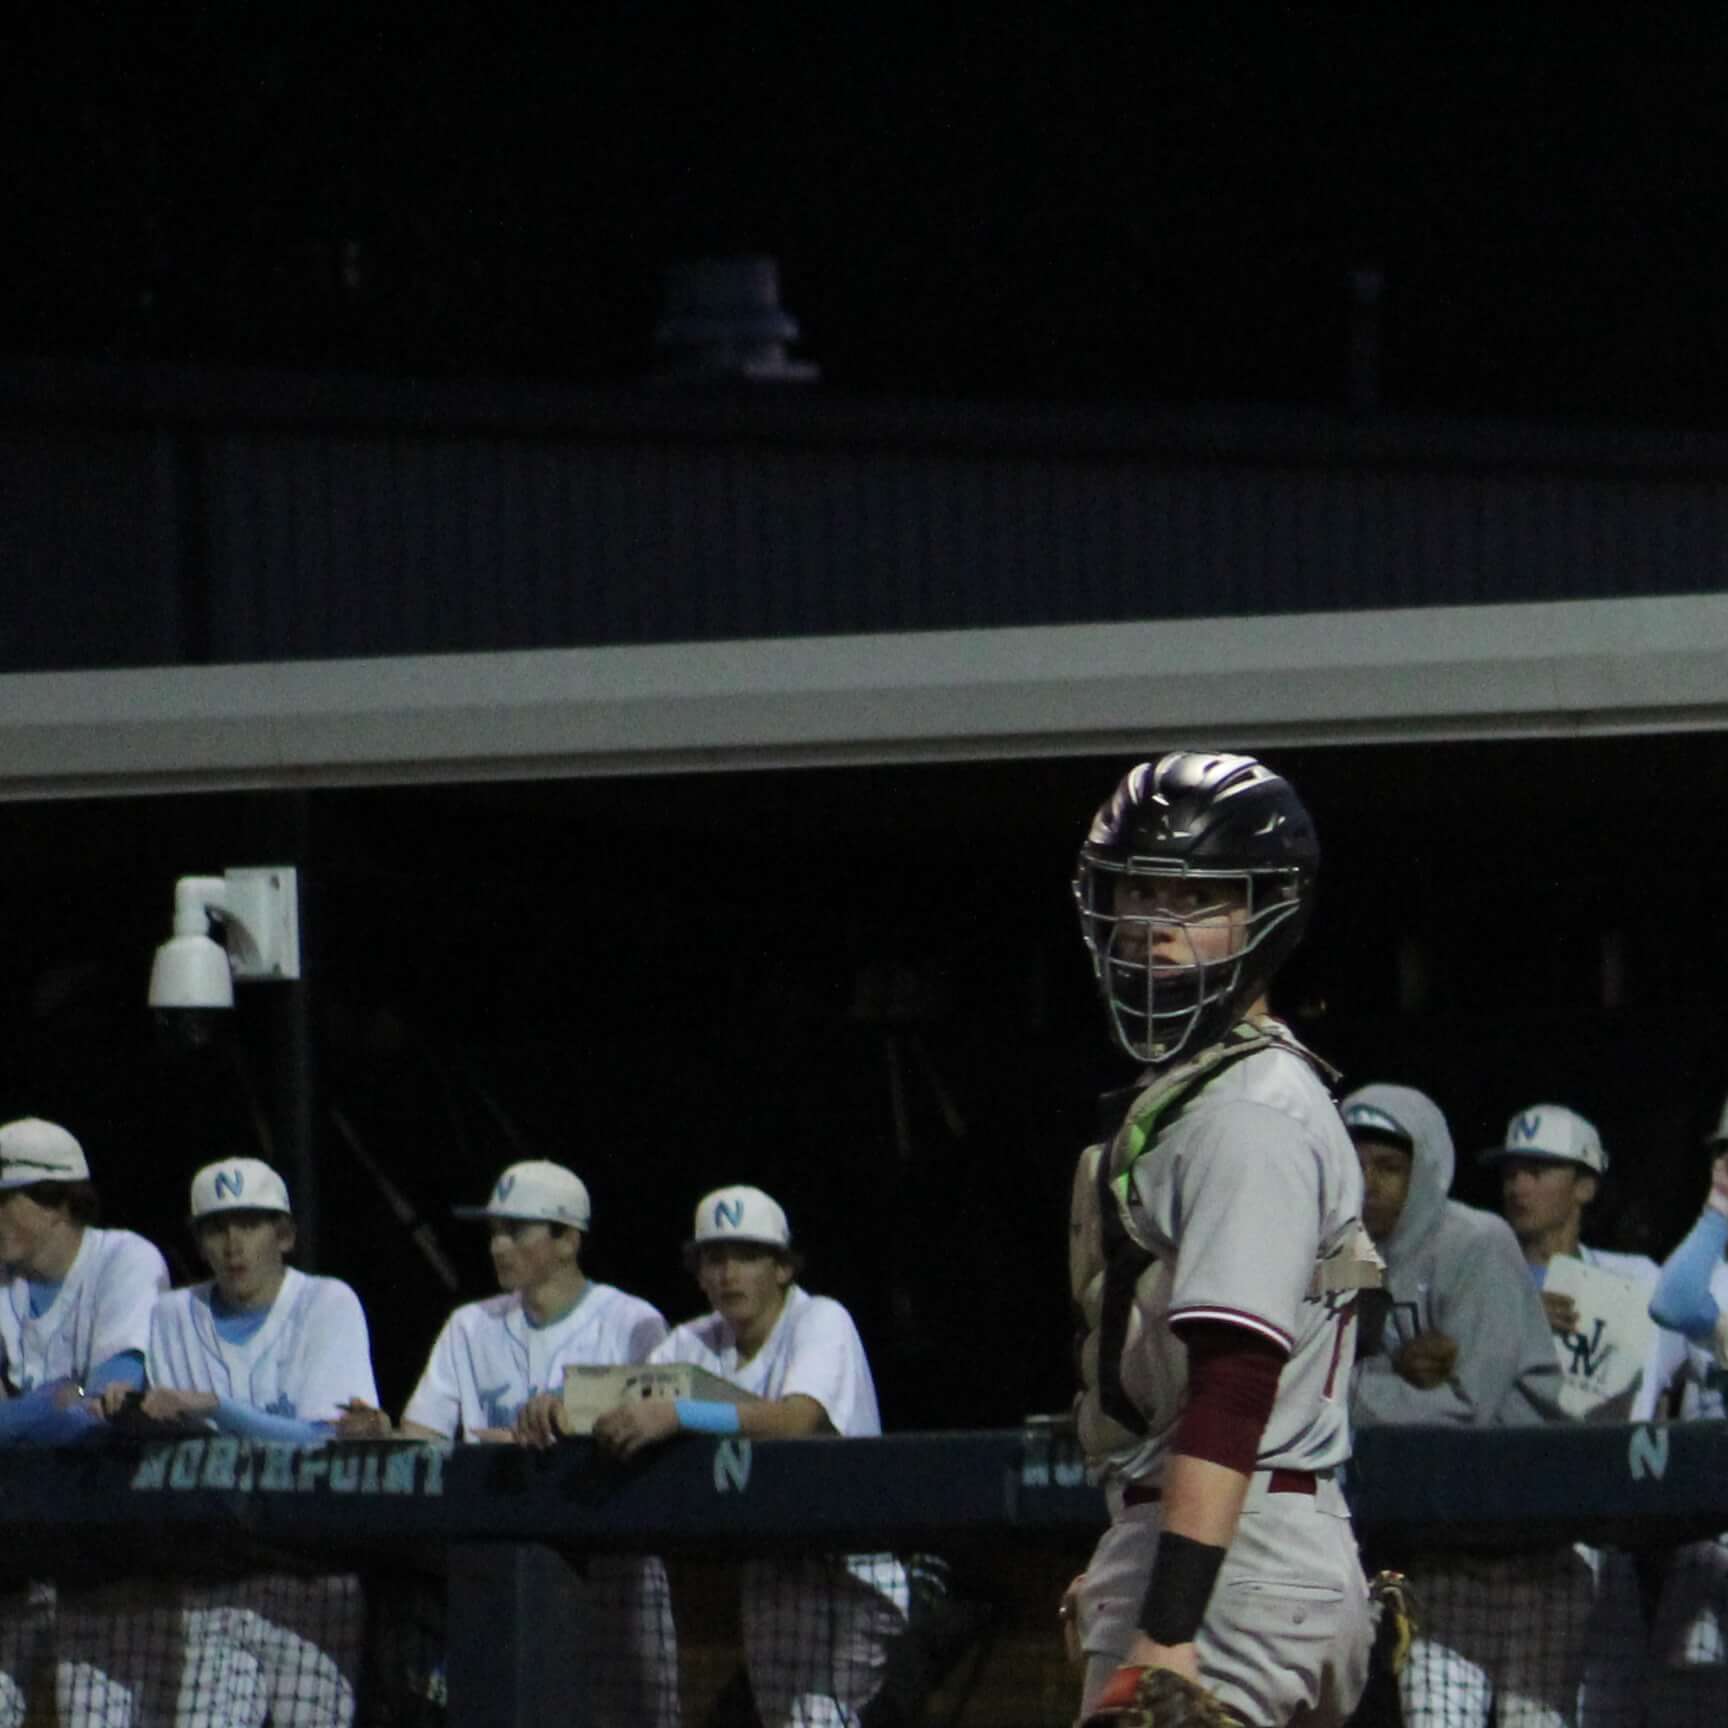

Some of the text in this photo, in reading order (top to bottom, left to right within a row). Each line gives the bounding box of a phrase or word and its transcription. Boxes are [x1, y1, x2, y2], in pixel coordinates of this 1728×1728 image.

[1512, 1113, 1543, 1142] N
[215, 1169, 244, 1201] N
[714, 1199, 744, 1230] N
[713, 1437, 753, 1494] N
[1629, 1423, 1670, 1482] N
